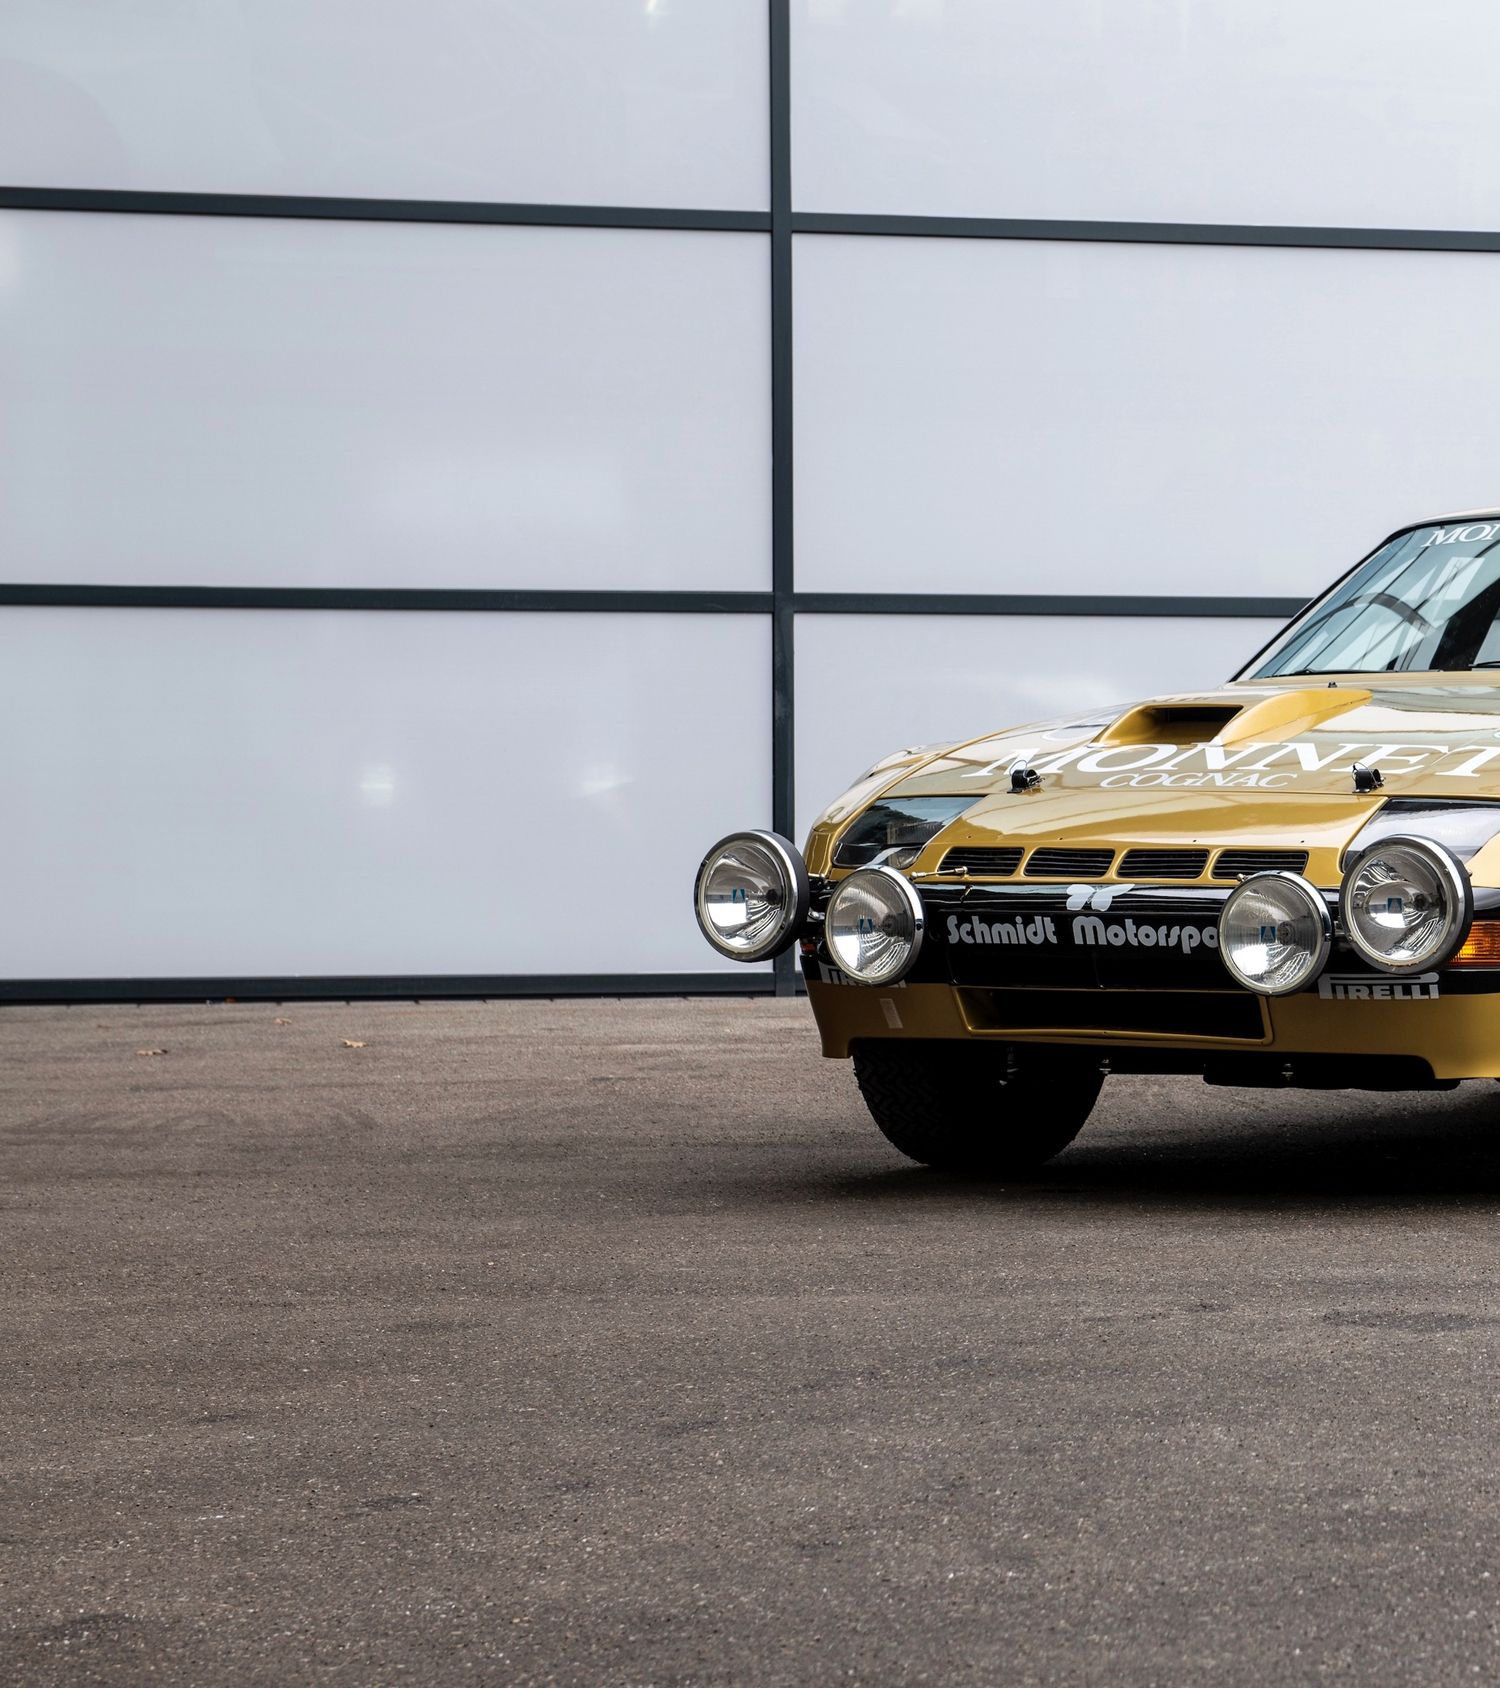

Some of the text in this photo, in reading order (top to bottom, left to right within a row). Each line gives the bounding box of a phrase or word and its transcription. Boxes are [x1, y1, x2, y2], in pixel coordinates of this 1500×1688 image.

[1100, 772, 1297, 788] COGNAC
[946, 915, 1218, 954] Schmidt Motorspo
[1318, 972, 1440, 1000] PIRELLI
